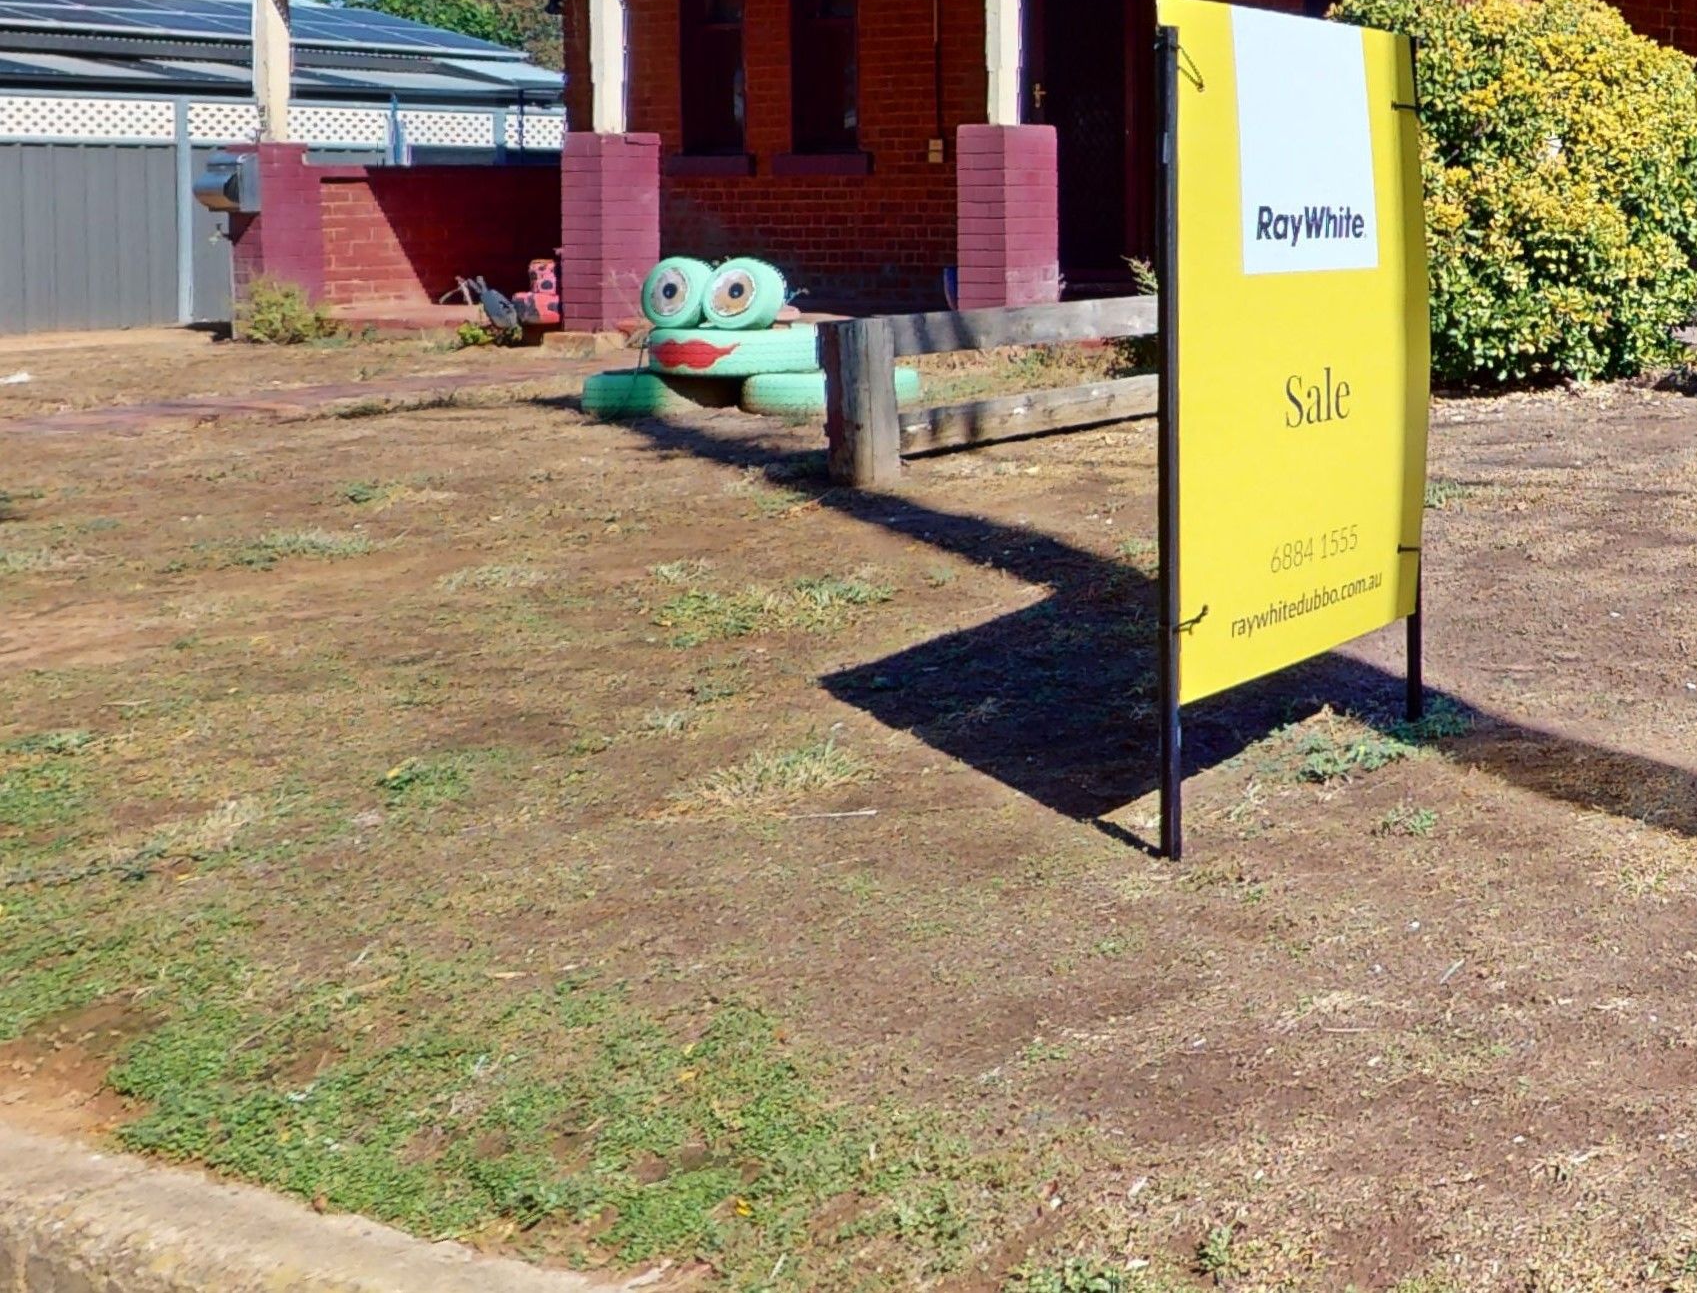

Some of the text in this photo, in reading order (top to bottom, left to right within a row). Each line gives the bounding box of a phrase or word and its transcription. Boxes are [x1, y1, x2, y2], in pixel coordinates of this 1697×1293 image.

[1285, 366, 1350, 428] Sale
[1270, 524, 1358, 574] 6884 1555
[1231, 572, 1383, 638] raywhitedubbo.com.au
